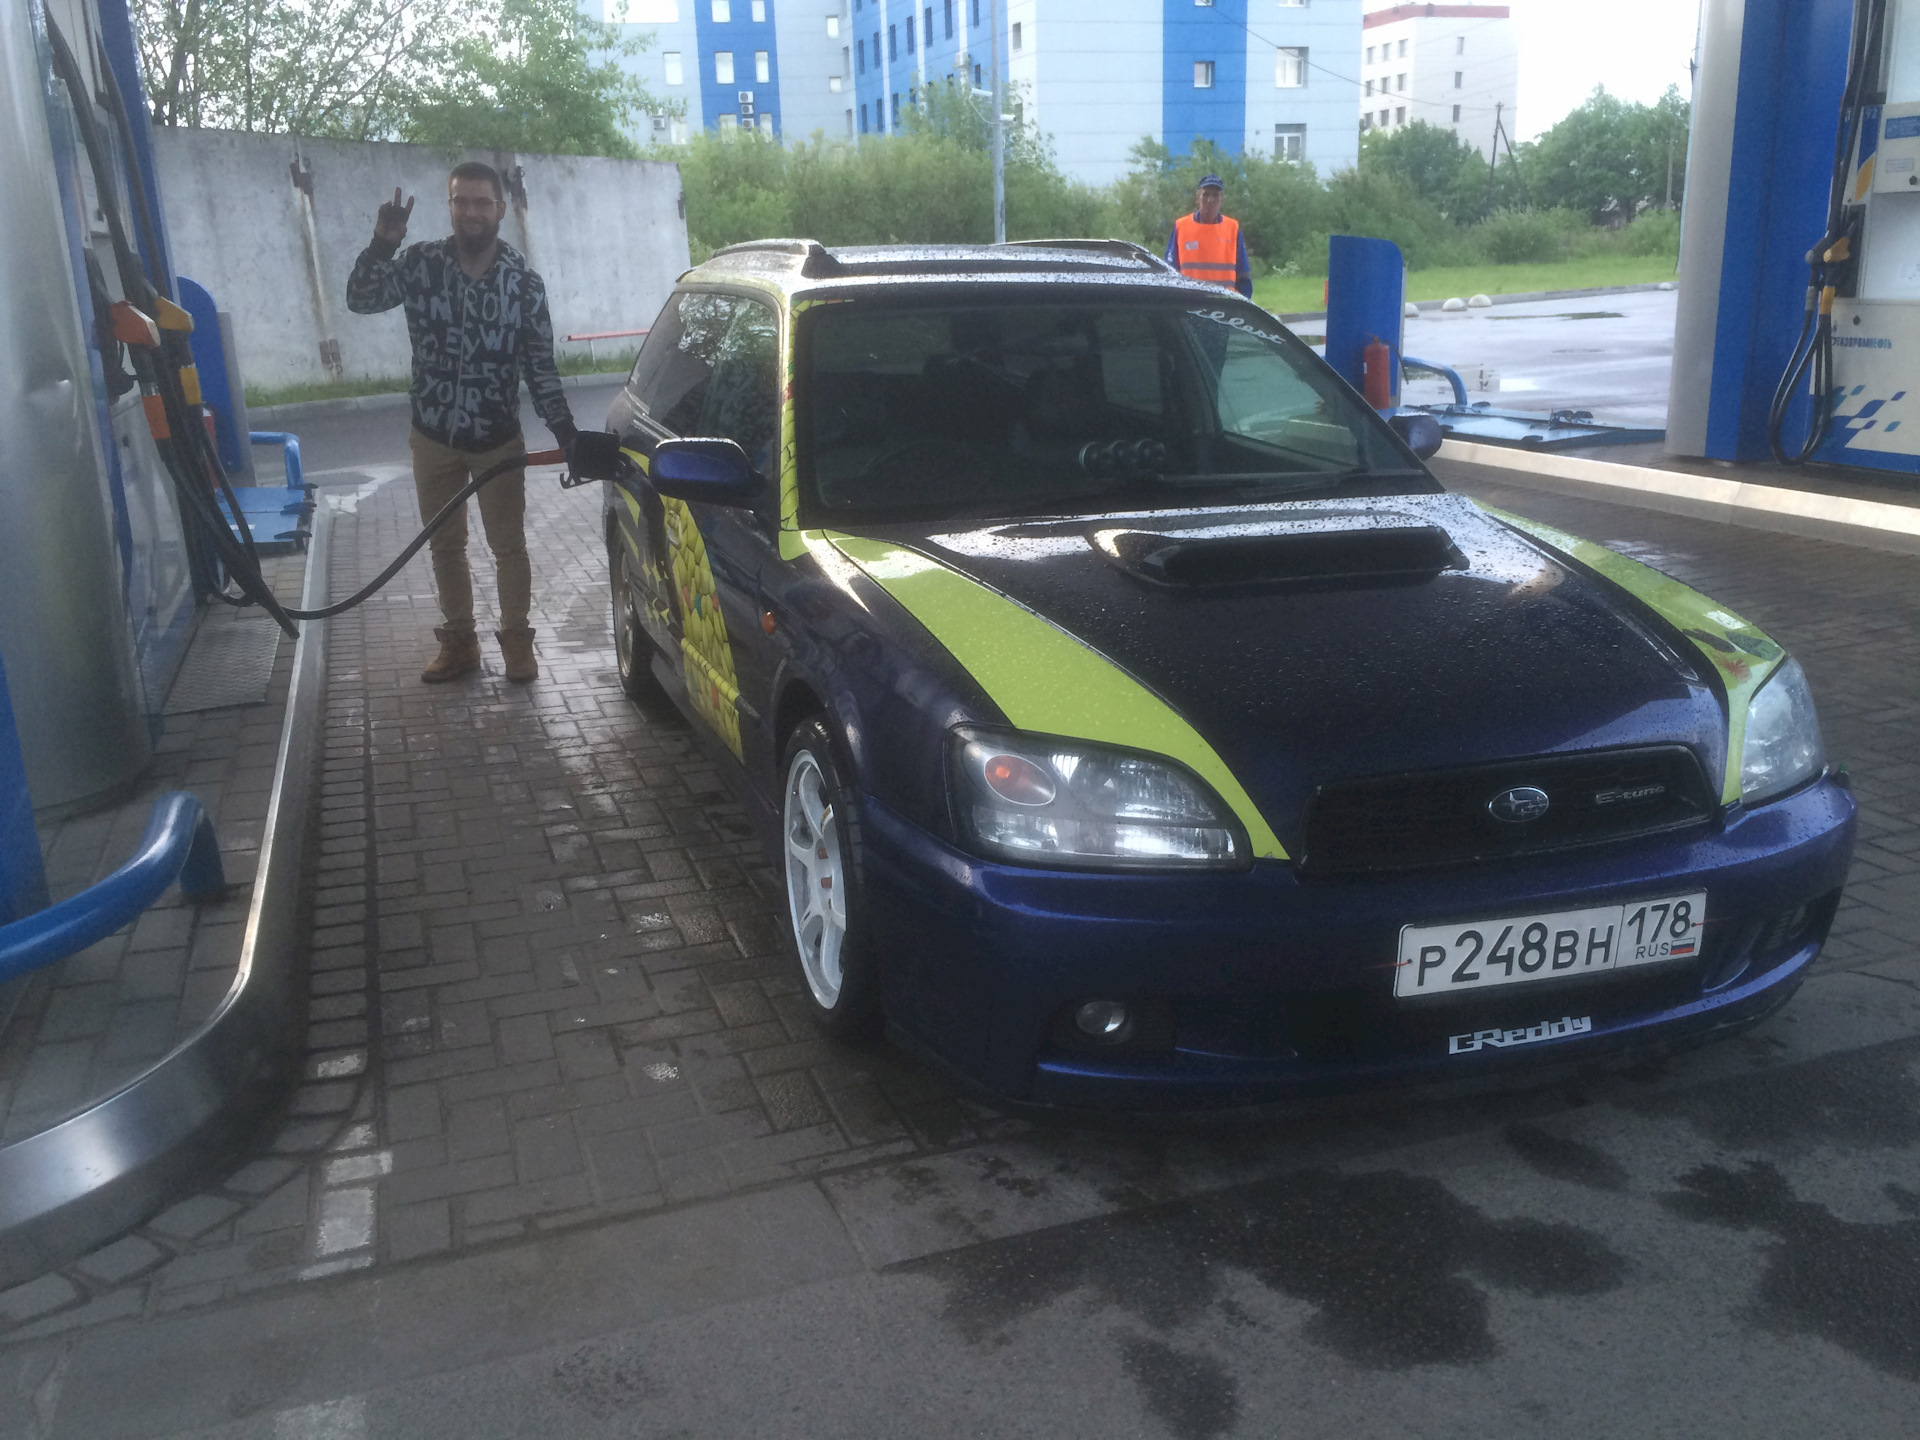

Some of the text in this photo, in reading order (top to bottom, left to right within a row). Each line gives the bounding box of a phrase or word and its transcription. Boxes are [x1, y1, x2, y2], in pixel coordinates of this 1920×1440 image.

[1595, 785, 1666, 805] E-tune
[1627, 900, 1691, 945] 178
[1635, 942, 1669, 960] RUS
